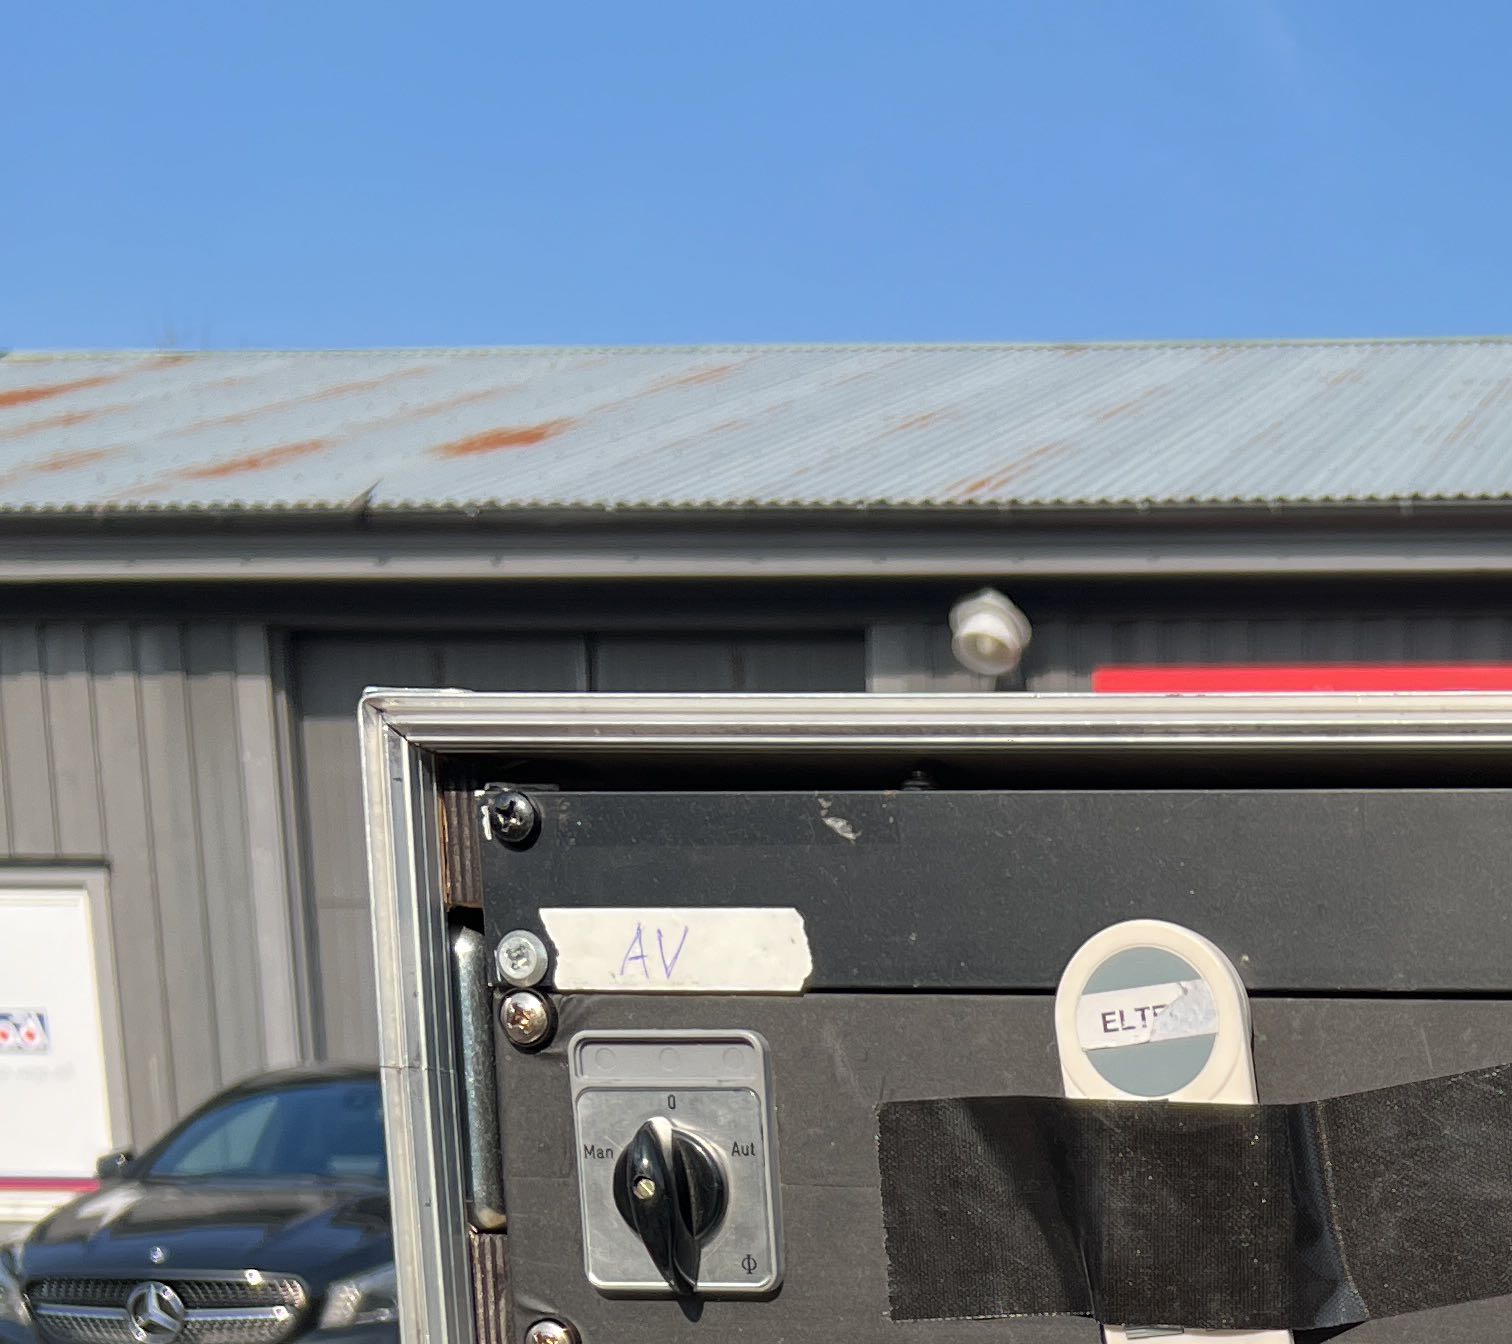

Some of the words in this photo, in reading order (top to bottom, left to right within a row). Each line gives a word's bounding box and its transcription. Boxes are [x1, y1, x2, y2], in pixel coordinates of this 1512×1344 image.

[620, 921, 689, 980] AV
[583, 1143, 614, 1160] Man
[730, 1140, 756, 1158] Aut
